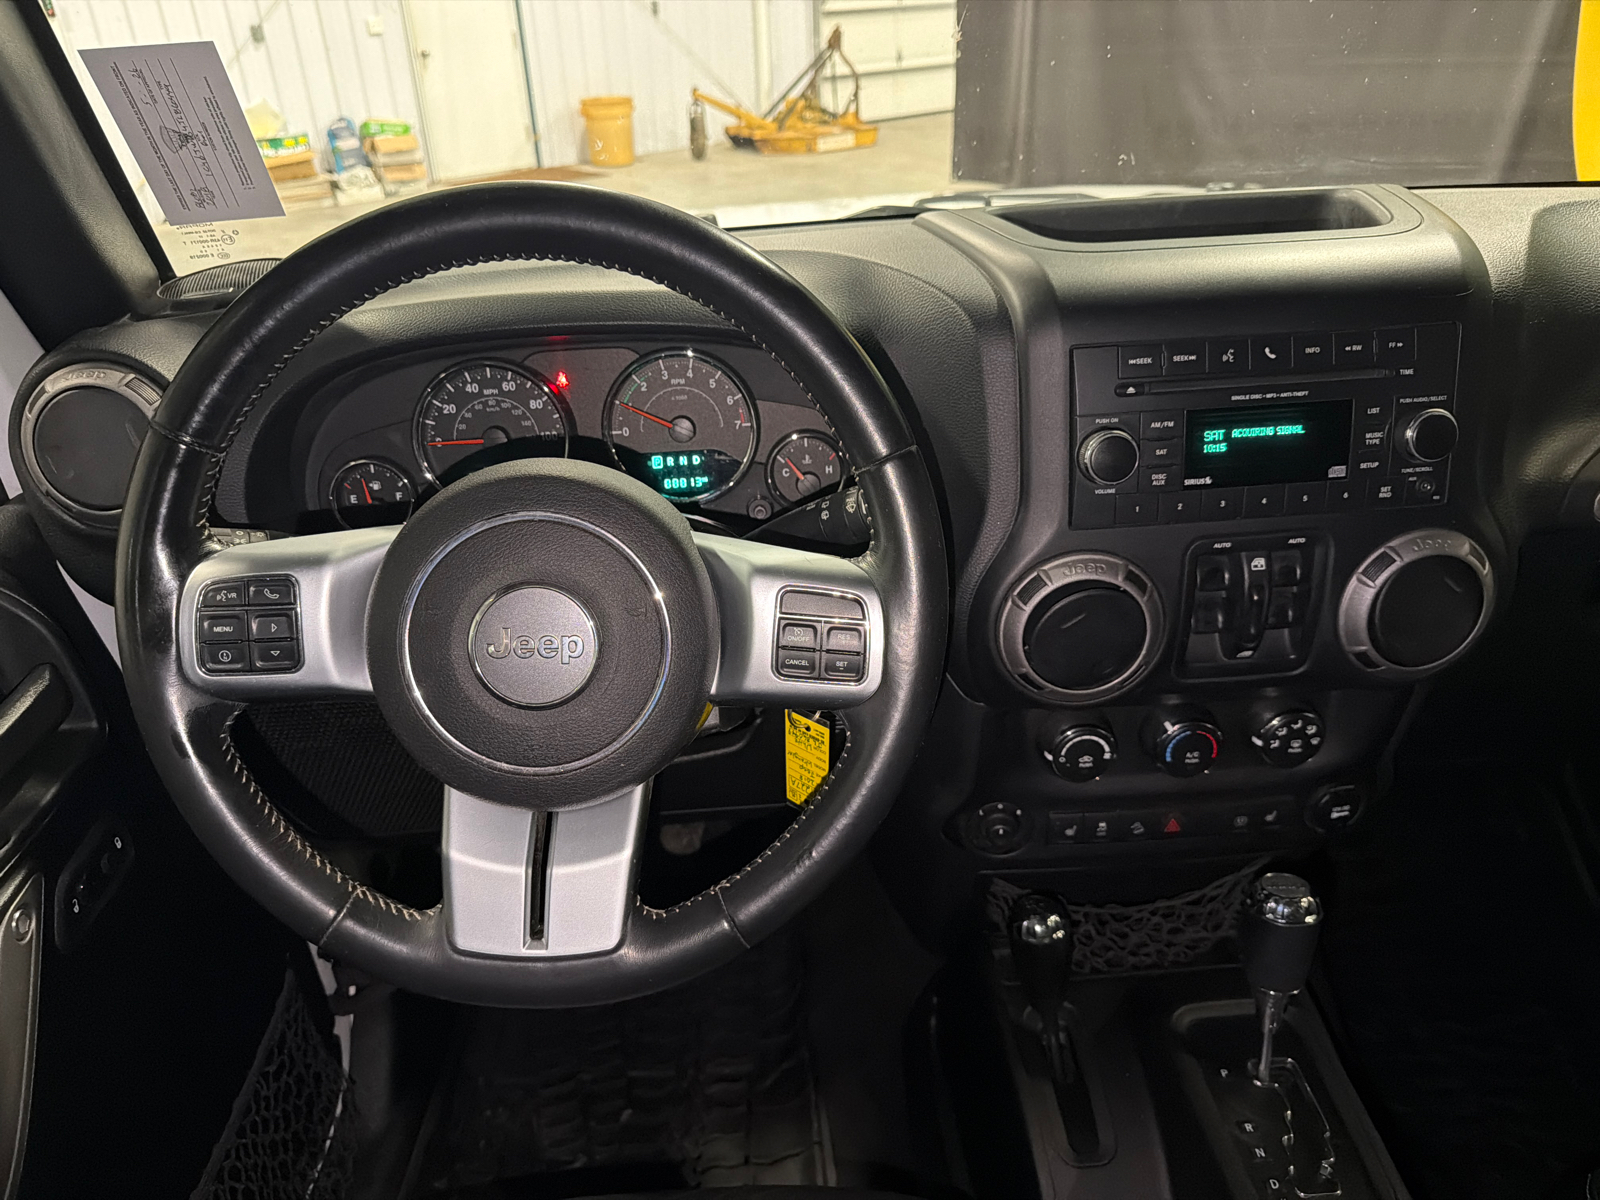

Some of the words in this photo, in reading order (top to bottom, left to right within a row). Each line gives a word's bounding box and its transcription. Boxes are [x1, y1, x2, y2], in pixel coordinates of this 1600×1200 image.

[1136, 357, 1153, 365] SEEK
[1173, 354, 1189, 362] SEEK
[661, 370, 669, 380] 3
[686, 369, 694, 378] 4
[502, 381, 516, 392] 60
[640, 382, 648, 391] 2
[671, 378, 686, 386] RPM
[709, 378, 716, 388] 5
[466, 383, 479, 394] 40
[530, 399, 543, 410] 80
[726, 396, 734, 405] 6
[442, 403, 457, 414] 20
[734, 421, 741, 430] 7
[1150, 421, 1174, 429] AM/FM
[622, 427, 630, 437] 0
[1203, 430, 1226, 441] SAT
[1231, 426, 1274, 438] ACQUIRING
[1276, 425, 1306, 435] SIGNAL
[1203, 443, 1227, 453] 10:15
[667, 456, 674, 467] R
[679, 455, 687, 466] N
[692, 454, 701, 465] D
[782, 468, 790, 477] C
[825, 465, 833, 474] H
[1184, 477, 1205, 486] SIRIUS
[350, 494, 358, 504] E
[395, 492, 403, 502] F
[1062, 562, 1107, 576] Jeep
[486, 627, 585, 665] Jeep
[1220, 1068, 1228, 1078] P
[1244, 1123, 1254, 1133] R
[1254, 1148, 1266, 1158] N
[1269, 1179, 1279, 1189] D
